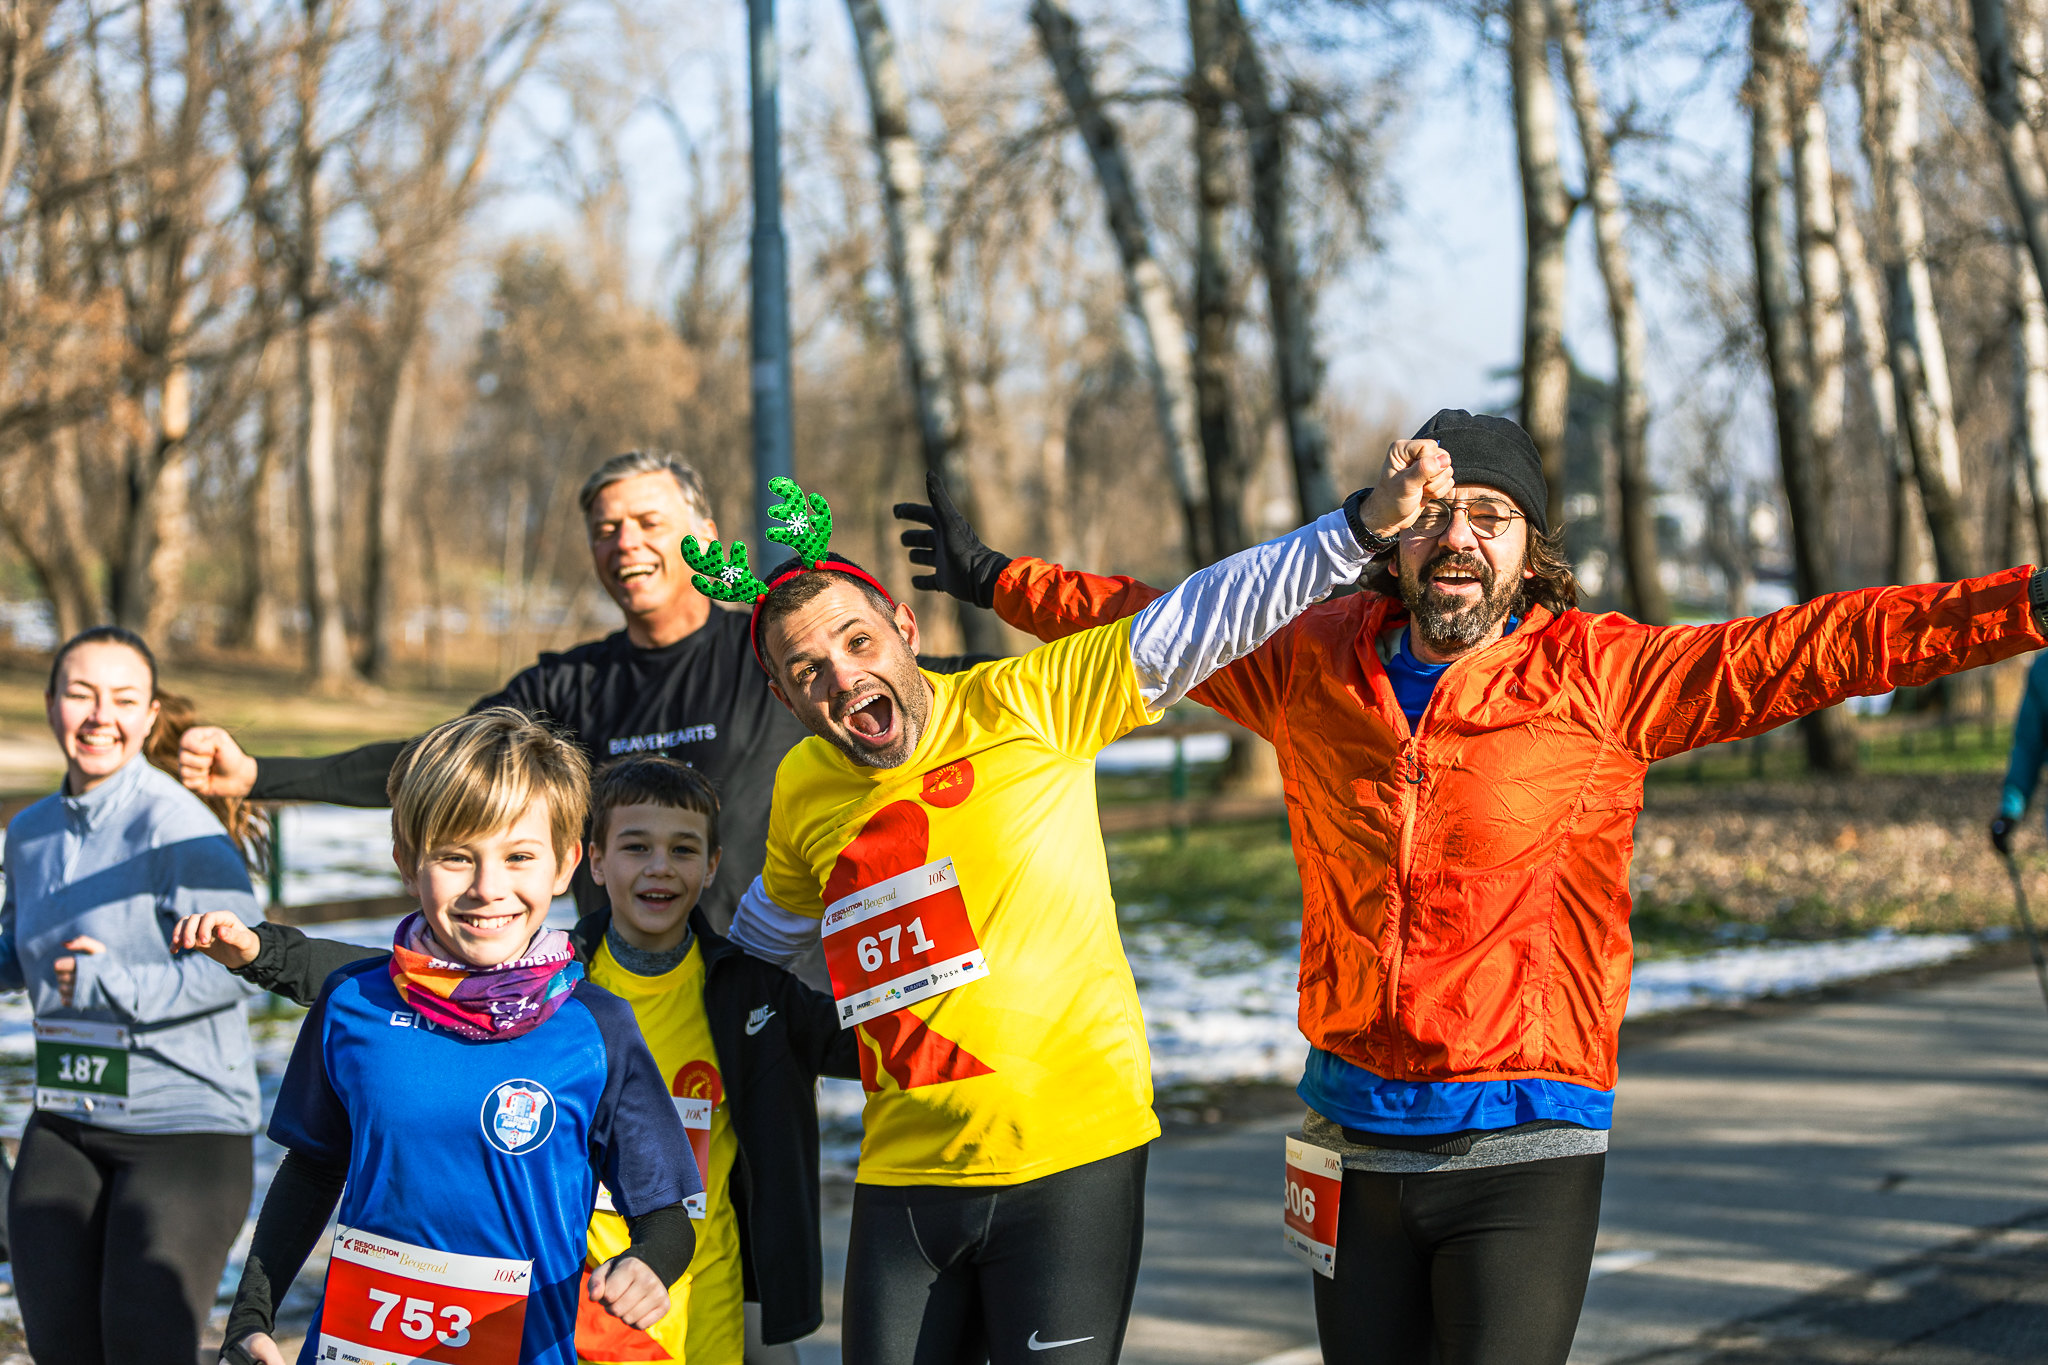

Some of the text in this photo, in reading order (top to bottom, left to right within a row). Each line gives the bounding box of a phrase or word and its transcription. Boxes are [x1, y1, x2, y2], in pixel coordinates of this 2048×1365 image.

[608, 723, 717, 755] BRAVEHEARTS
[928, 869, 946, 885] 10K
[831, 888, 896, 918] RESOLUTION Beograd
[857, 916, 935, 973] 671
[749, 1004, 769, 1025] NIKE
[57, 1053, 109, 1085] 187
[685, 1109, 702, 1121] 10K
[1324, 1157, 1338, 1171] 10K
[353, 1245, 369, 1255] RUN
[354, 1239, 448, 1274] RESOLUTION Beograd
[493, 1269, 519, 1283] 10K
[368, 1287, 472, 1348] 753
